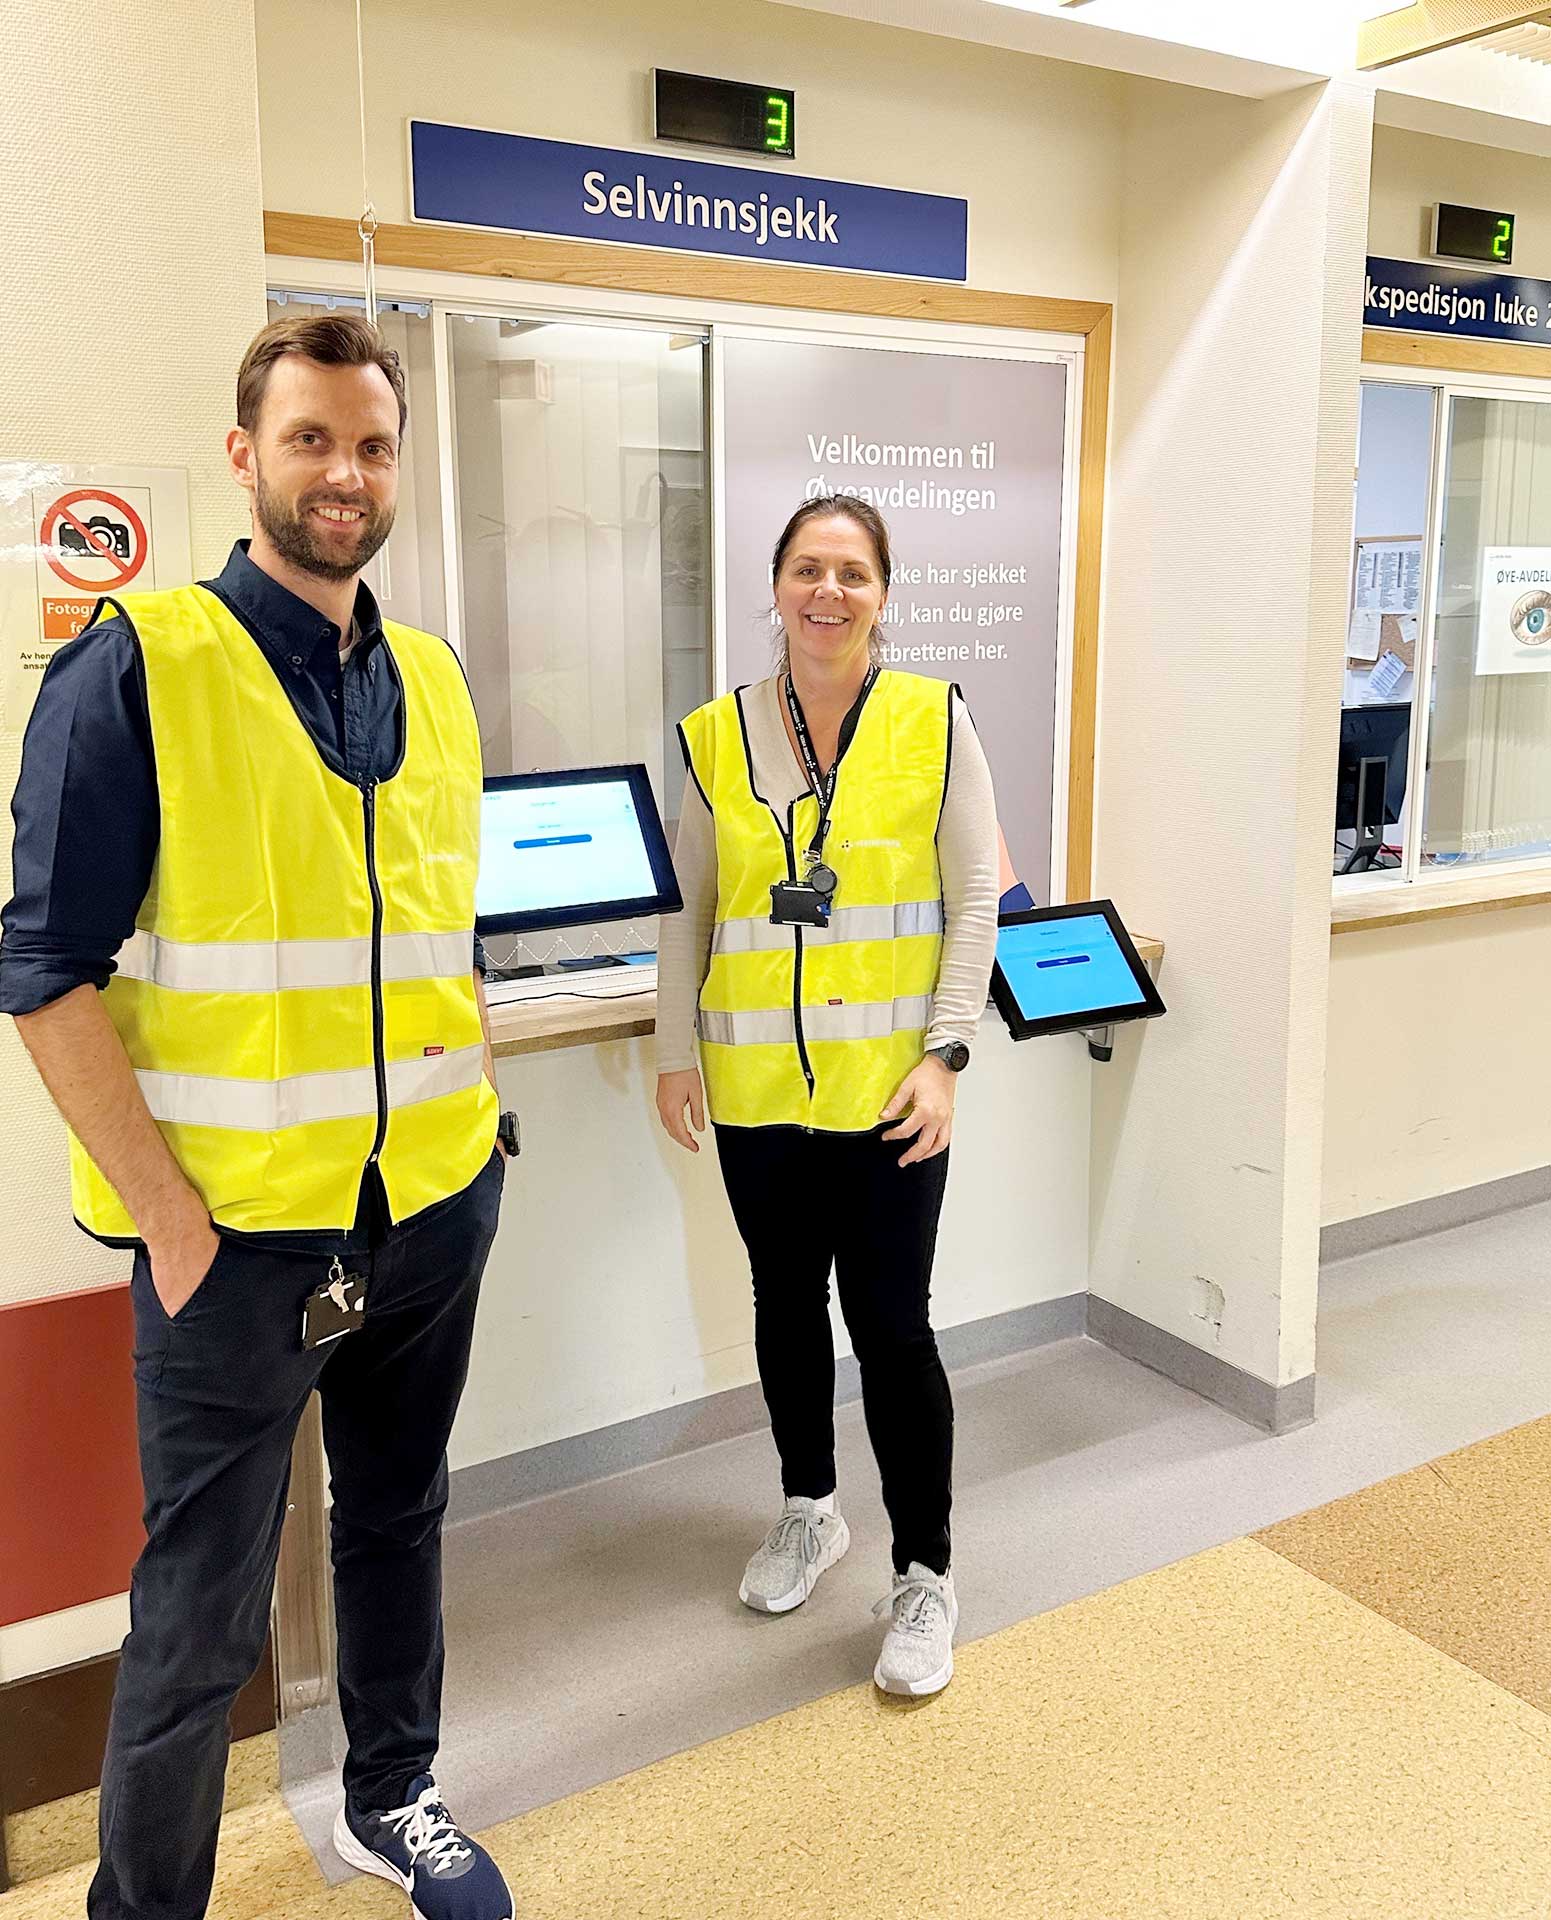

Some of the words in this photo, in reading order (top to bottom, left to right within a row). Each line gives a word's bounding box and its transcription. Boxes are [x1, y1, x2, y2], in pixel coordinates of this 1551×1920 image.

[766, 97, 788, 147] 3
[582, 169, 839, 246] Selvinnsjekk
[1492, 219, 1511, 257] 2
[1493, 292, 1539, 328] luke
[807, 434, 963, 469] Velkommen
[970, 441, 995, 470] til
[888, 562, 922, 585] kke
[926, 562, 958, 584] har
[962, 563, 1027, 589] sjekket
[909, 602, 944, 624] kan
[949, 602, 973, 623] du
[976, 603, 1024, 627] gjøre
[34, 652, 53, 660] hen
[879, 641, 970, 663] tbrettene
[974, 640, 1009, 661] her.
